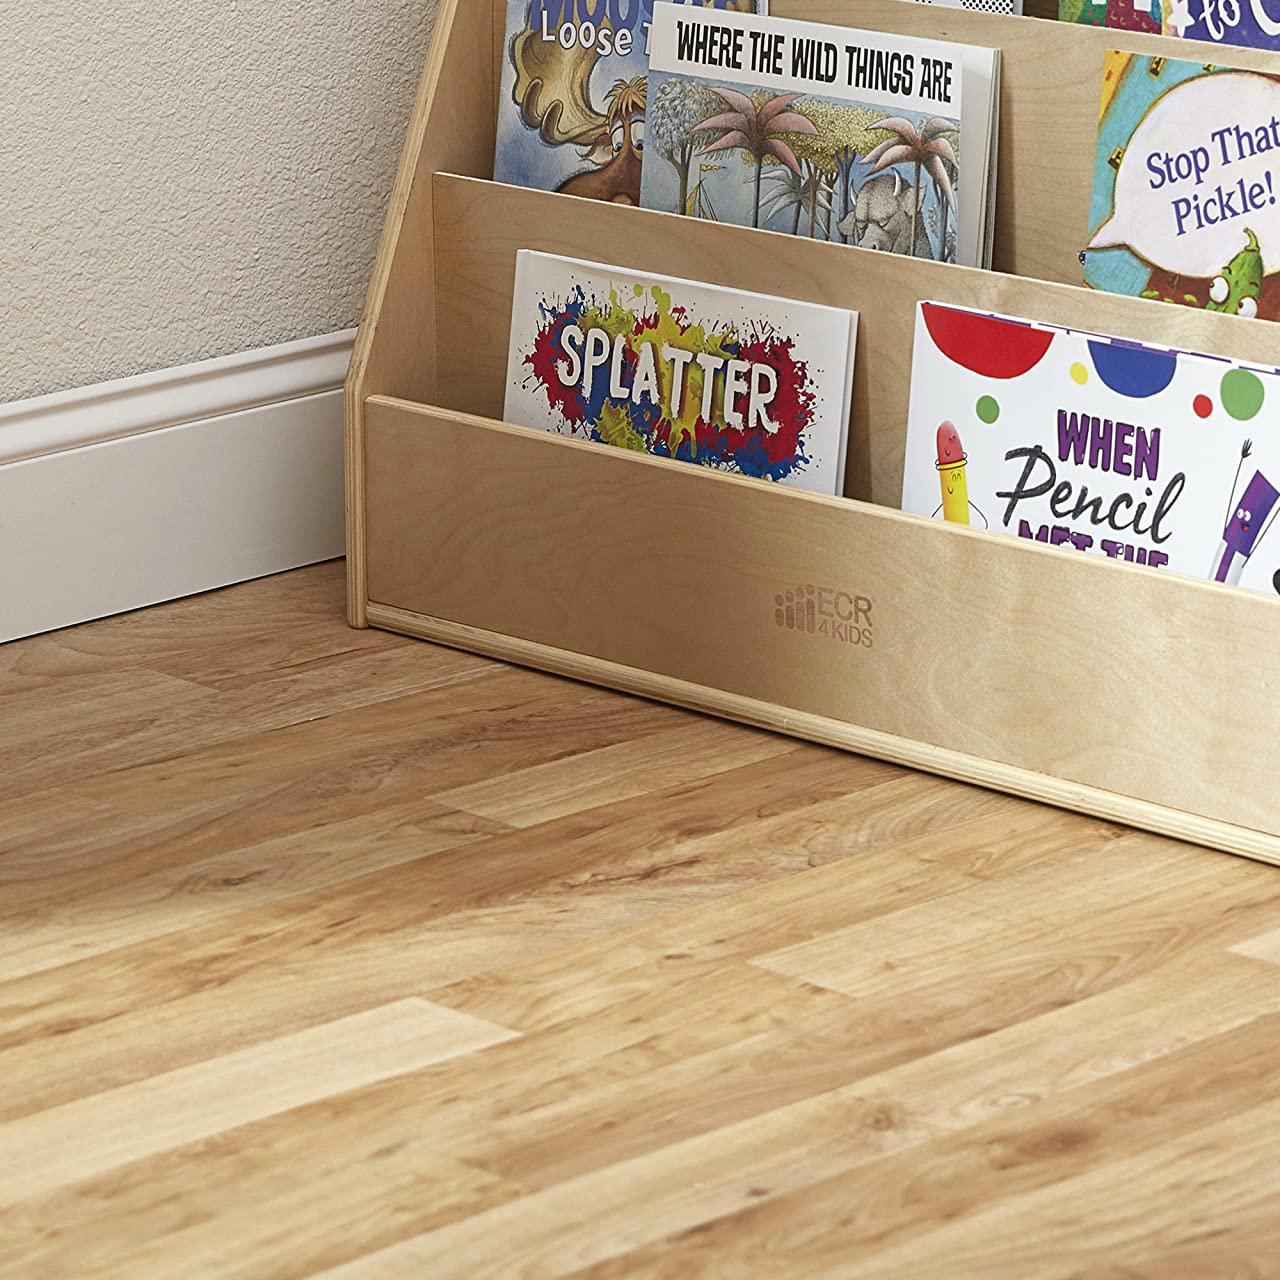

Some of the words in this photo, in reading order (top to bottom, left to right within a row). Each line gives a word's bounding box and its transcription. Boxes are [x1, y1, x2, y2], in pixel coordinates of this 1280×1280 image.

[676, 20, 742, 69] WHERE
[749, 31, 784, 74] THE
[790, 37, 837, 83] WILD
[845, 45, 914, 96] THINGS
[919, 57, 953, 103] ARE
[1146, 144, 1210, 189] Stop
[1171, 170, 1276, 236] Pickle!
[555, 324, 780, 436] SPLATTER
[1057, 408, 1161, 481] WHEN
[996, 444, 1186, 544] Pencil
[817, 586, 873, 628] ECR
